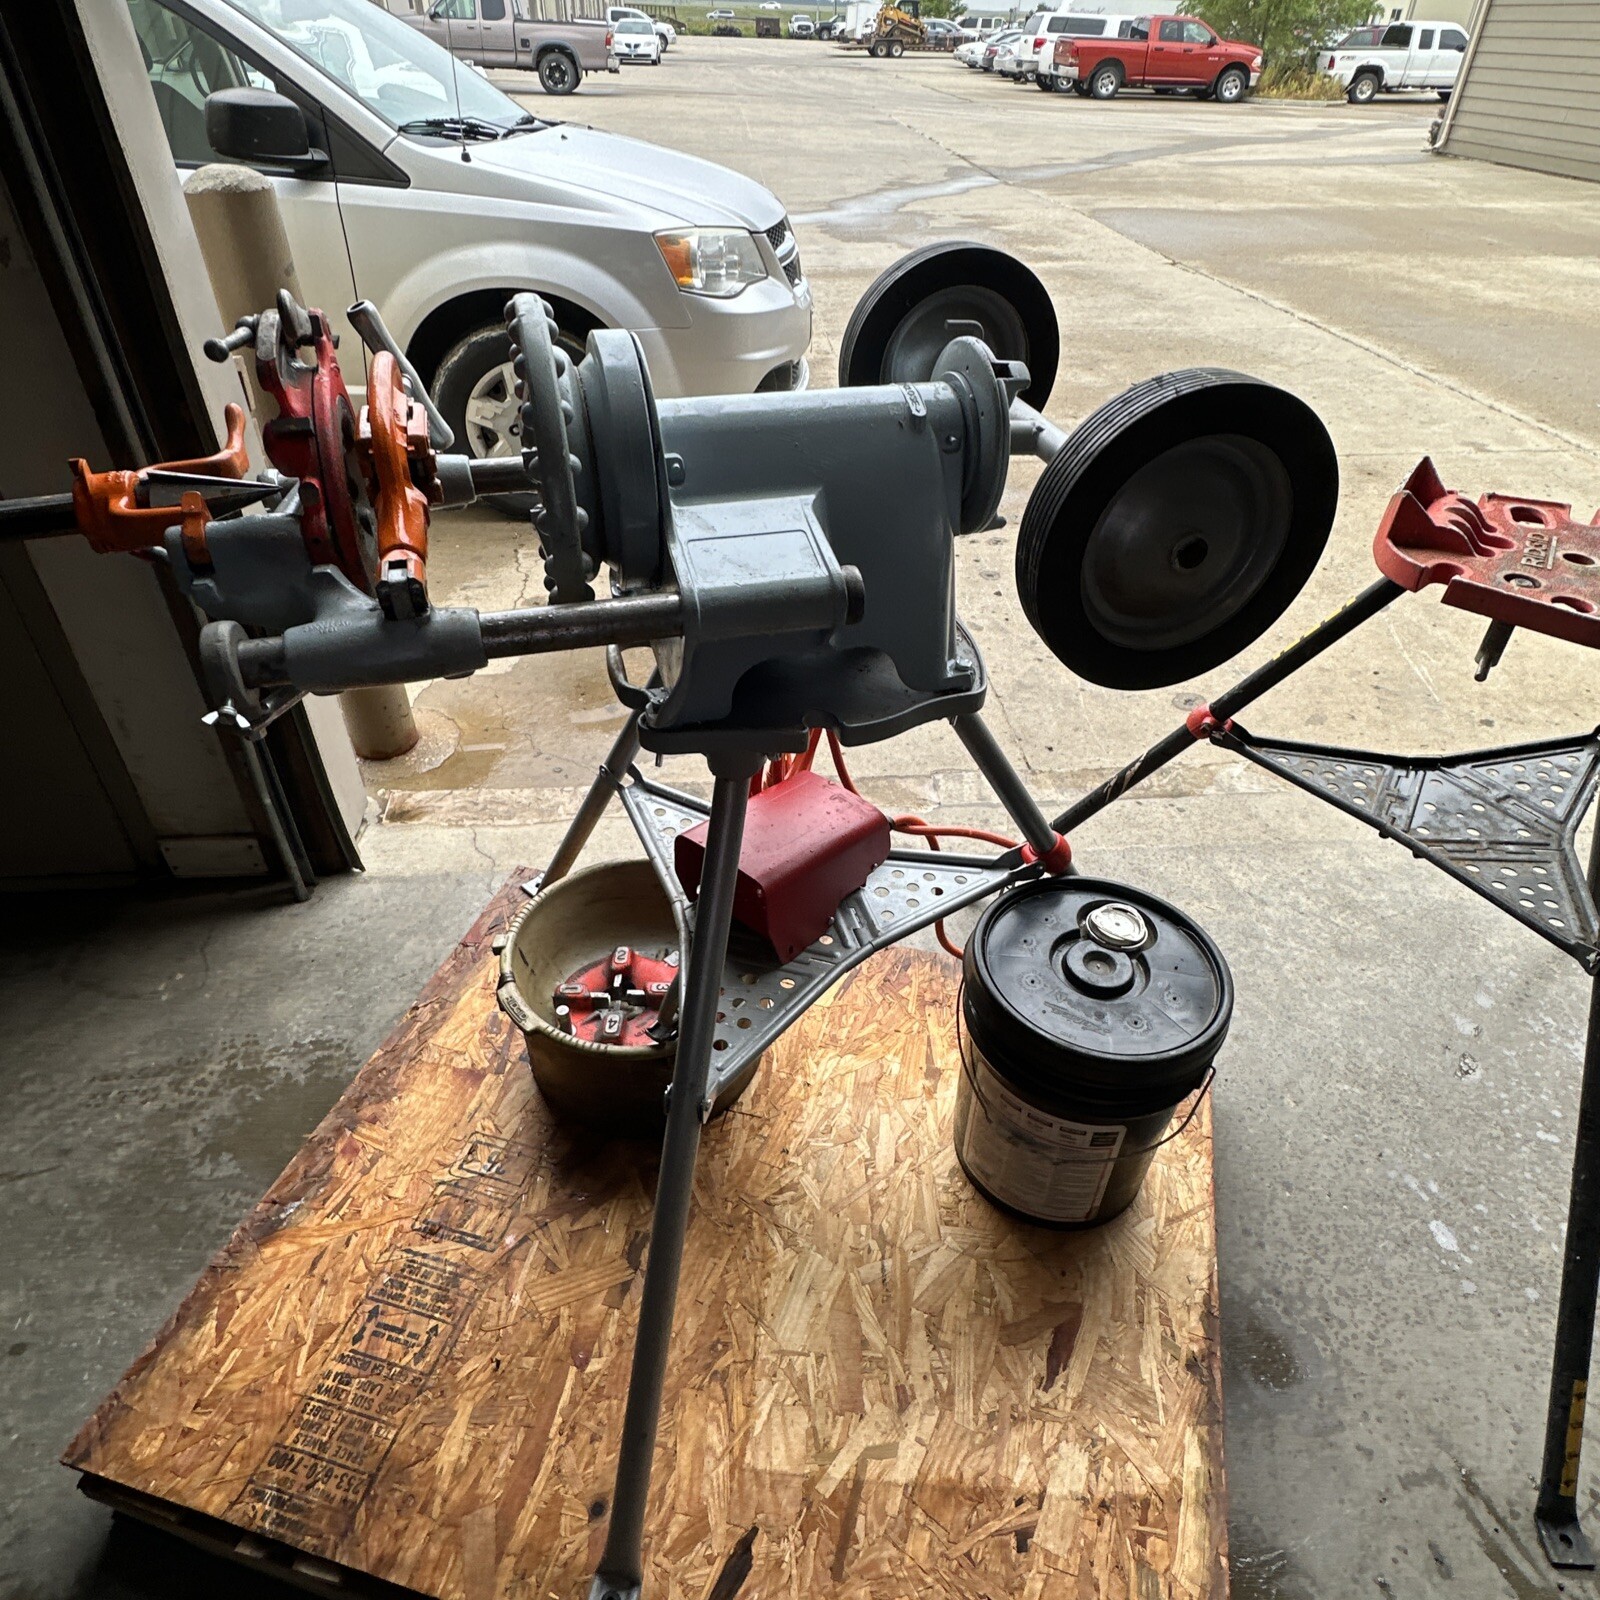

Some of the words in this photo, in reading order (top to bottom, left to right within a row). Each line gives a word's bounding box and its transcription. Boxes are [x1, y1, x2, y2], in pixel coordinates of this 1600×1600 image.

[1520, 532, 1549, 569] RIDGID
[617, 951, 627, 961] 2
[655, 983, 671, 992] 3
[504, 996, 528, 1025] RIDGID
[607, 1018, 619, 1030] 4
[291, 1432, 331, 1453] PANELS
